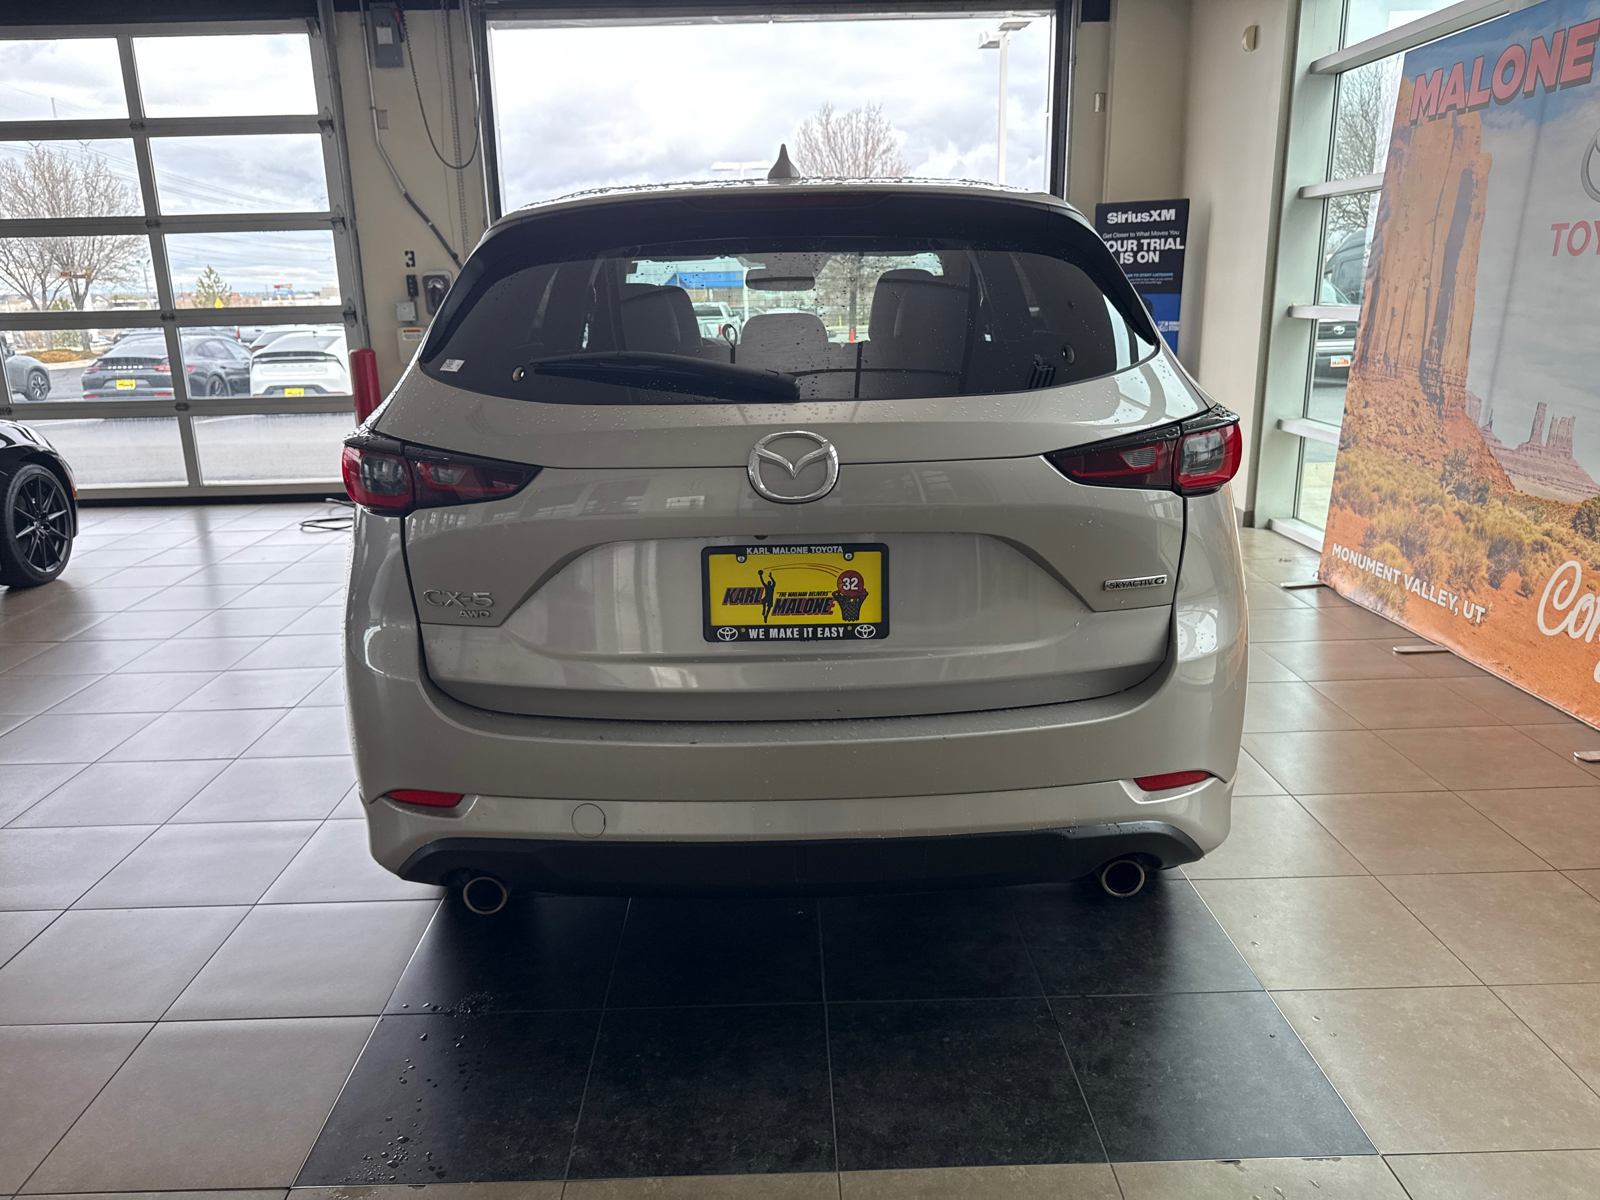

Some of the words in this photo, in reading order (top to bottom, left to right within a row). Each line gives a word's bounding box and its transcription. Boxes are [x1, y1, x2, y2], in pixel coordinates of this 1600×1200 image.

[1409, 18, 1600, 126] MALONE
[1106, 208, 1176, 224] SiriusXM
[1104, 239, 1138, 253] OUR
[1140, 237, 1185, 251] TRIAL
[404, 250, 416, 268] 3
[1119, 251, 1134, 264] IS
[1136, 251, 1160, 263] ON
[746, 547, 769, 555] KARL
[772, 546, 809, 554] MALONE
[810, 546, 844, 554] TOYOTA
[842, 577, 859, 591] 32
[1331, 542, 1402, 585] MONUMENT
[1404, 572, 1460, 616] VALLEY,
[1463, 601, 1486, 624] UT
[423, 589, 495, 608] CX-5
[722, 587, 765, 605] KARL
[459, 610, 491, 618] AWD
[771, 597, 835, 616] MALONE
[749, 628, 765, 639] WE
[769, 627, 799, 639] MAKE
[803, 627, 814, 638] IT
[817, 626, 845, 638] EASY
